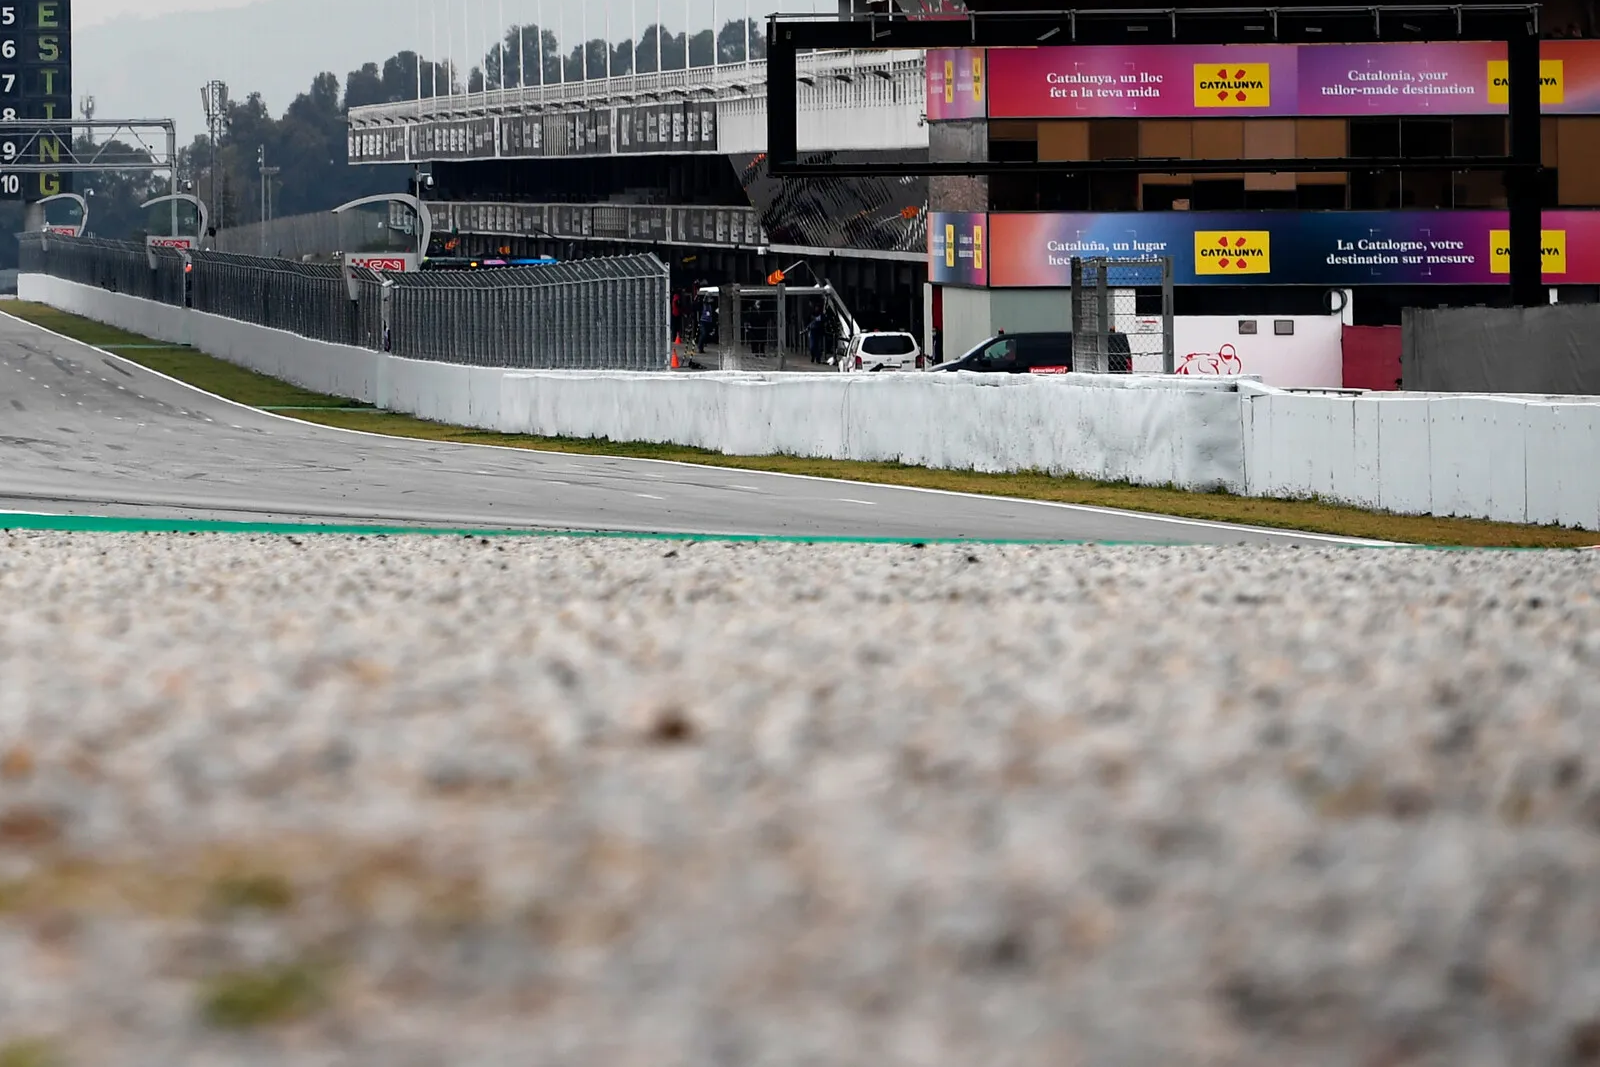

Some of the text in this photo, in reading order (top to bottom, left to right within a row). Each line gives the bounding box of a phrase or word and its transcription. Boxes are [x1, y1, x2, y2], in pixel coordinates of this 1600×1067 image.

[2, 6, 15, 25] 5
[1, 39, 16, 59] 6
[1046, 72, 1163, 85] Catalunya, un lloc
[1347, 69, 1449, 83] Catalonia, your
[2, 73, 16, 93] 7
[1199, 81, 1263, 90] CATALUNYA
[1321, 83, 1475, 95] tailor-made destination
[1049, 87, 1160, 98] fet a la teva mida
[2, 107, 16, 122] 8
[2, 141, 16, 161] 9
[0, 174, 19, 194] 10
[1047, 240, 1167, 252] Cataluña, un lugar
[1337, 239, 1464, 252] La Catalogne, votre
[1200, 248, 1264, 257] CATALUNYA
[1326, 253, 1475, 265] destination sur mesure
